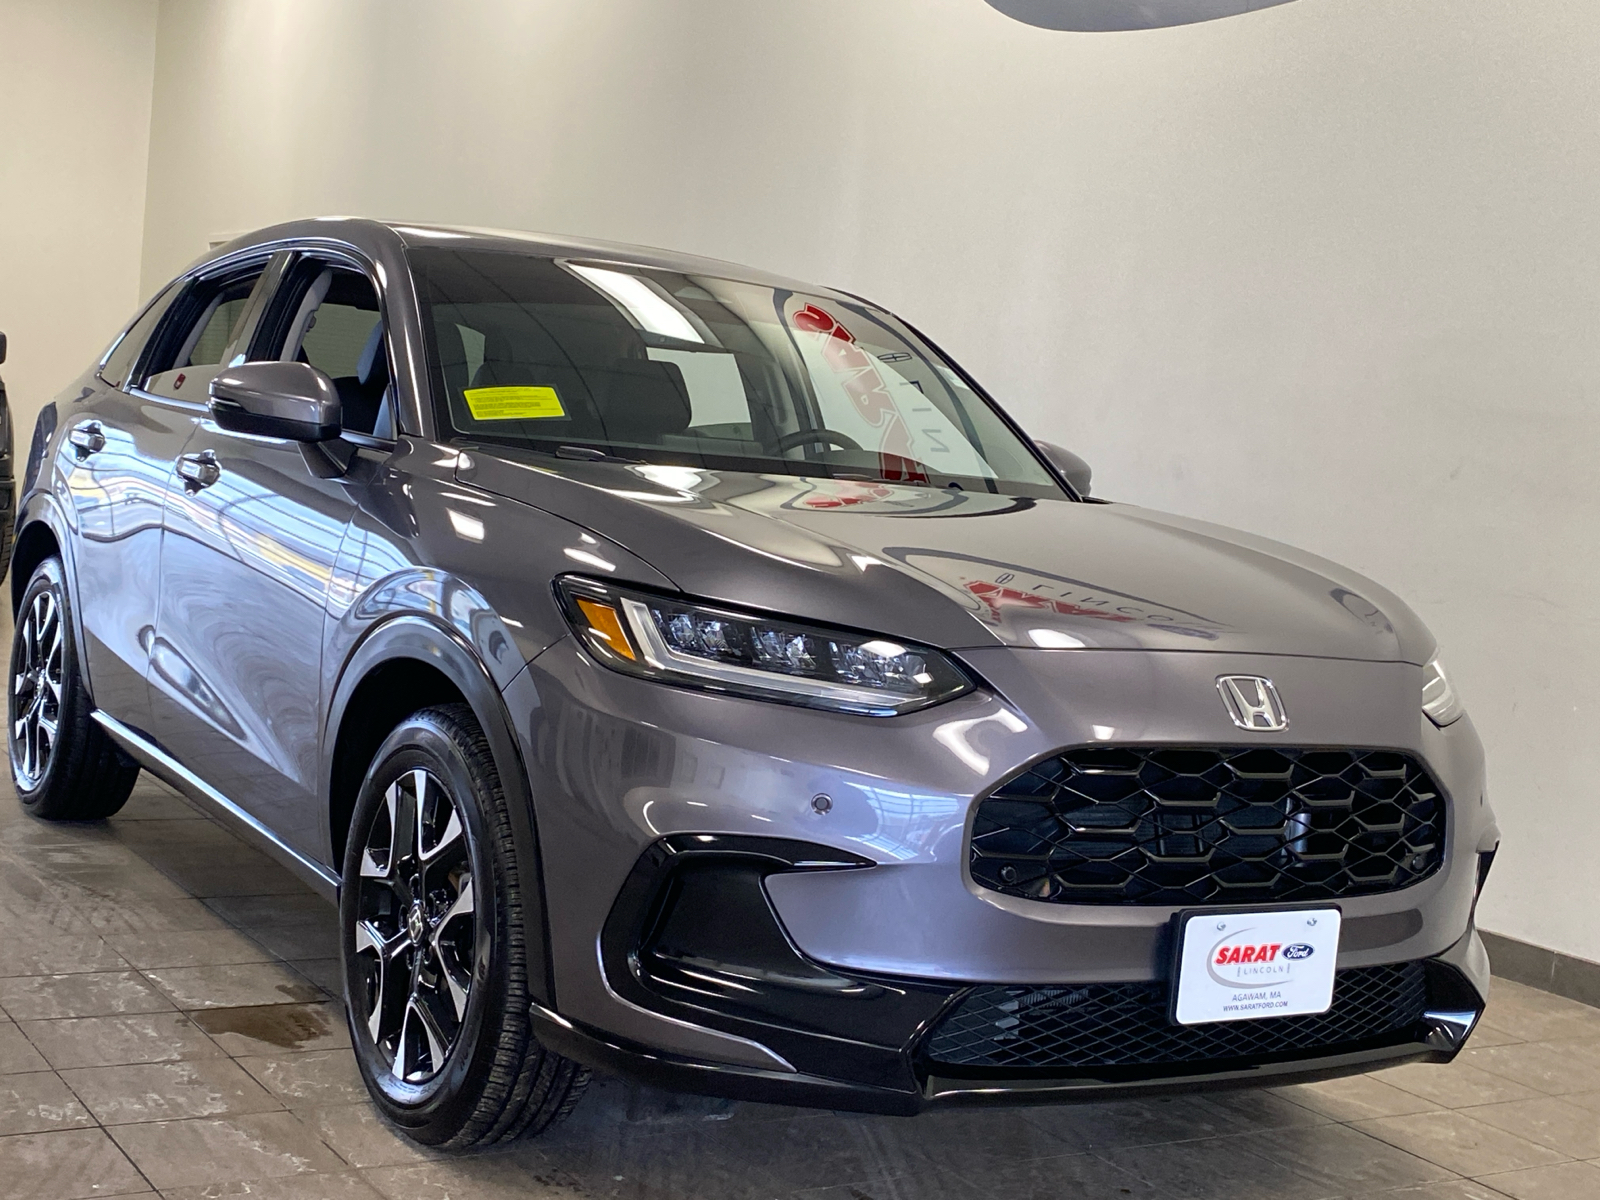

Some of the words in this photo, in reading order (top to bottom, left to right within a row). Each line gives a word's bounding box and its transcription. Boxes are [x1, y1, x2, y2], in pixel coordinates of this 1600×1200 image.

[1215, 944, 1281, 965] SARAT
[1287, 945, 1309, 957] Ford
[1244, 966, 1283, 974] LINCOLN
[1232, 992, 1268, 1001] AGAWAM,
[1223, 1001, 1288, 1011] WWW.SARATFORD.COM
